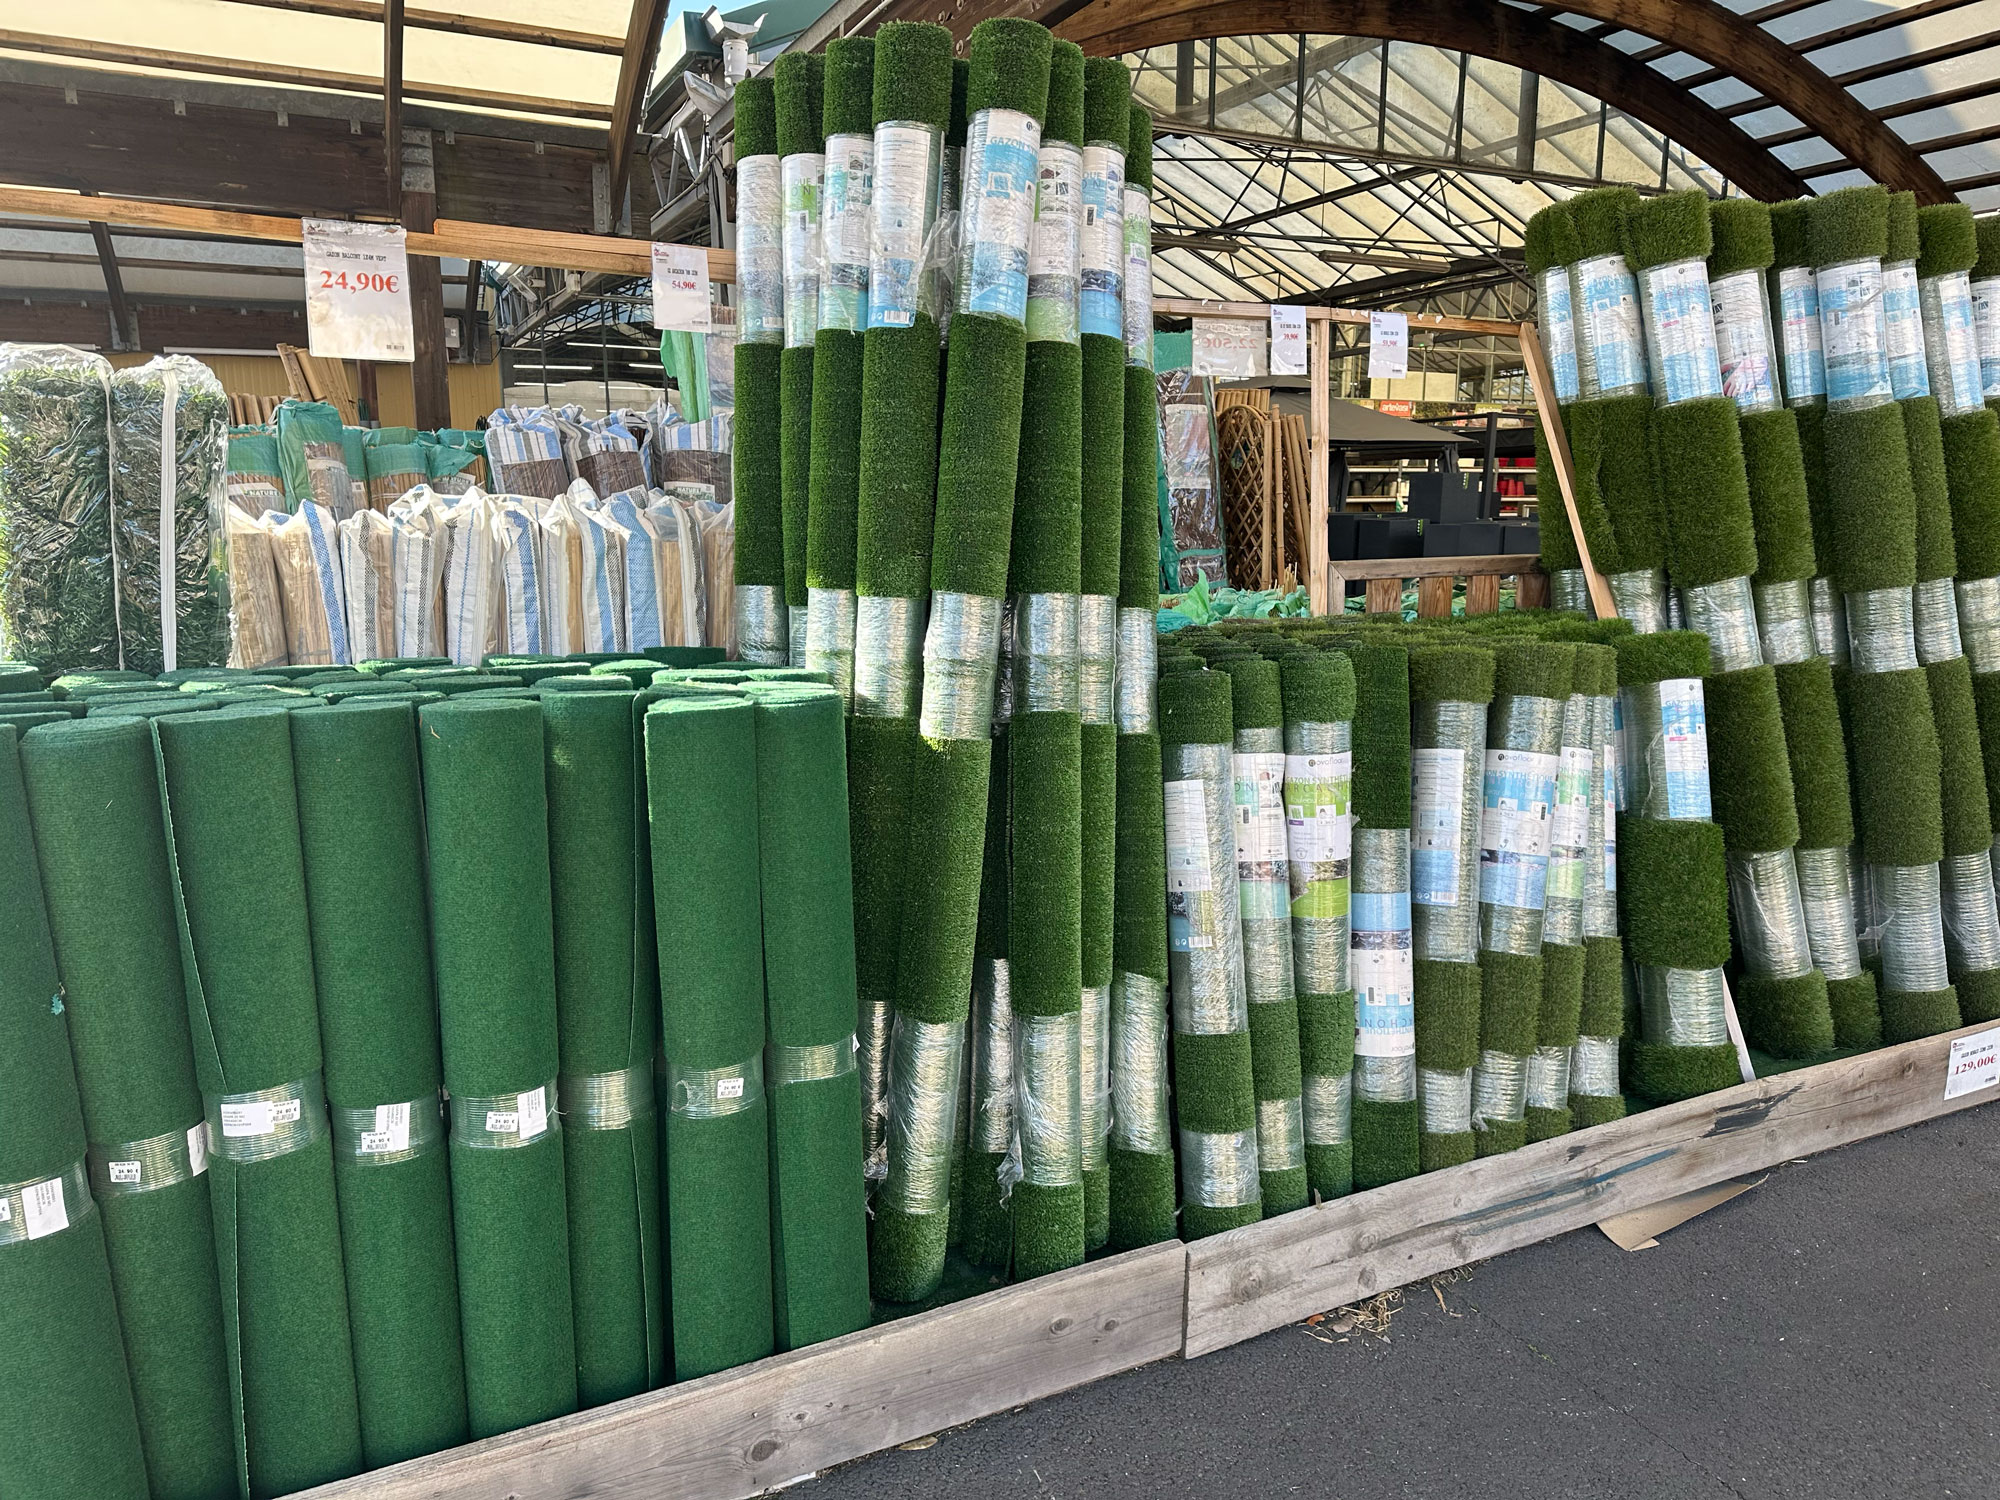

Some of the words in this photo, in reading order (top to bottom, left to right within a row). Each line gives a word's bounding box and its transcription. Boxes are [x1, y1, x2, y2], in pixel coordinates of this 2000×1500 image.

[320, 270, 400, 294] 24,90€
[671, 280, 697, 291] 54,90€
[1954, 1054, 1998, 1076] 129,00€
